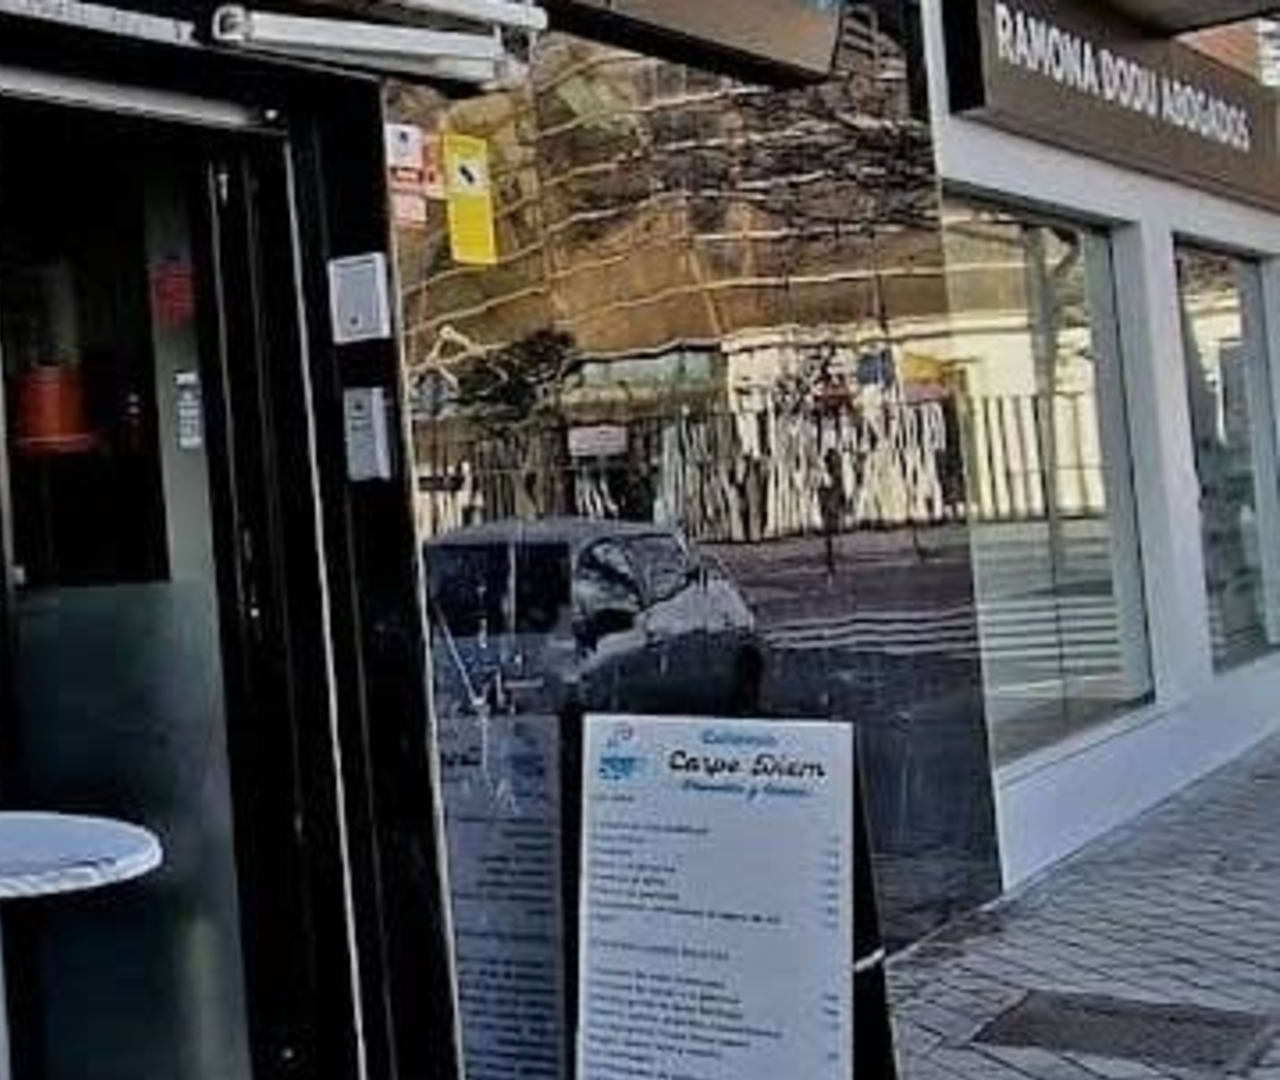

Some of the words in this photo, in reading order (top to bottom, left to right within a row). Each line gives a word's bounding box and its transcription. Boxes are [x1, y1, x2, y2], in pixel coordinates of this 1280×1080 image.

[994, 3, 1099, 96] RAMONA
[1162, 76, 1251, 152] ABOGADOS
[669, 749, 741, 777] Carpe
[751, 752, 826, 778] Diem
